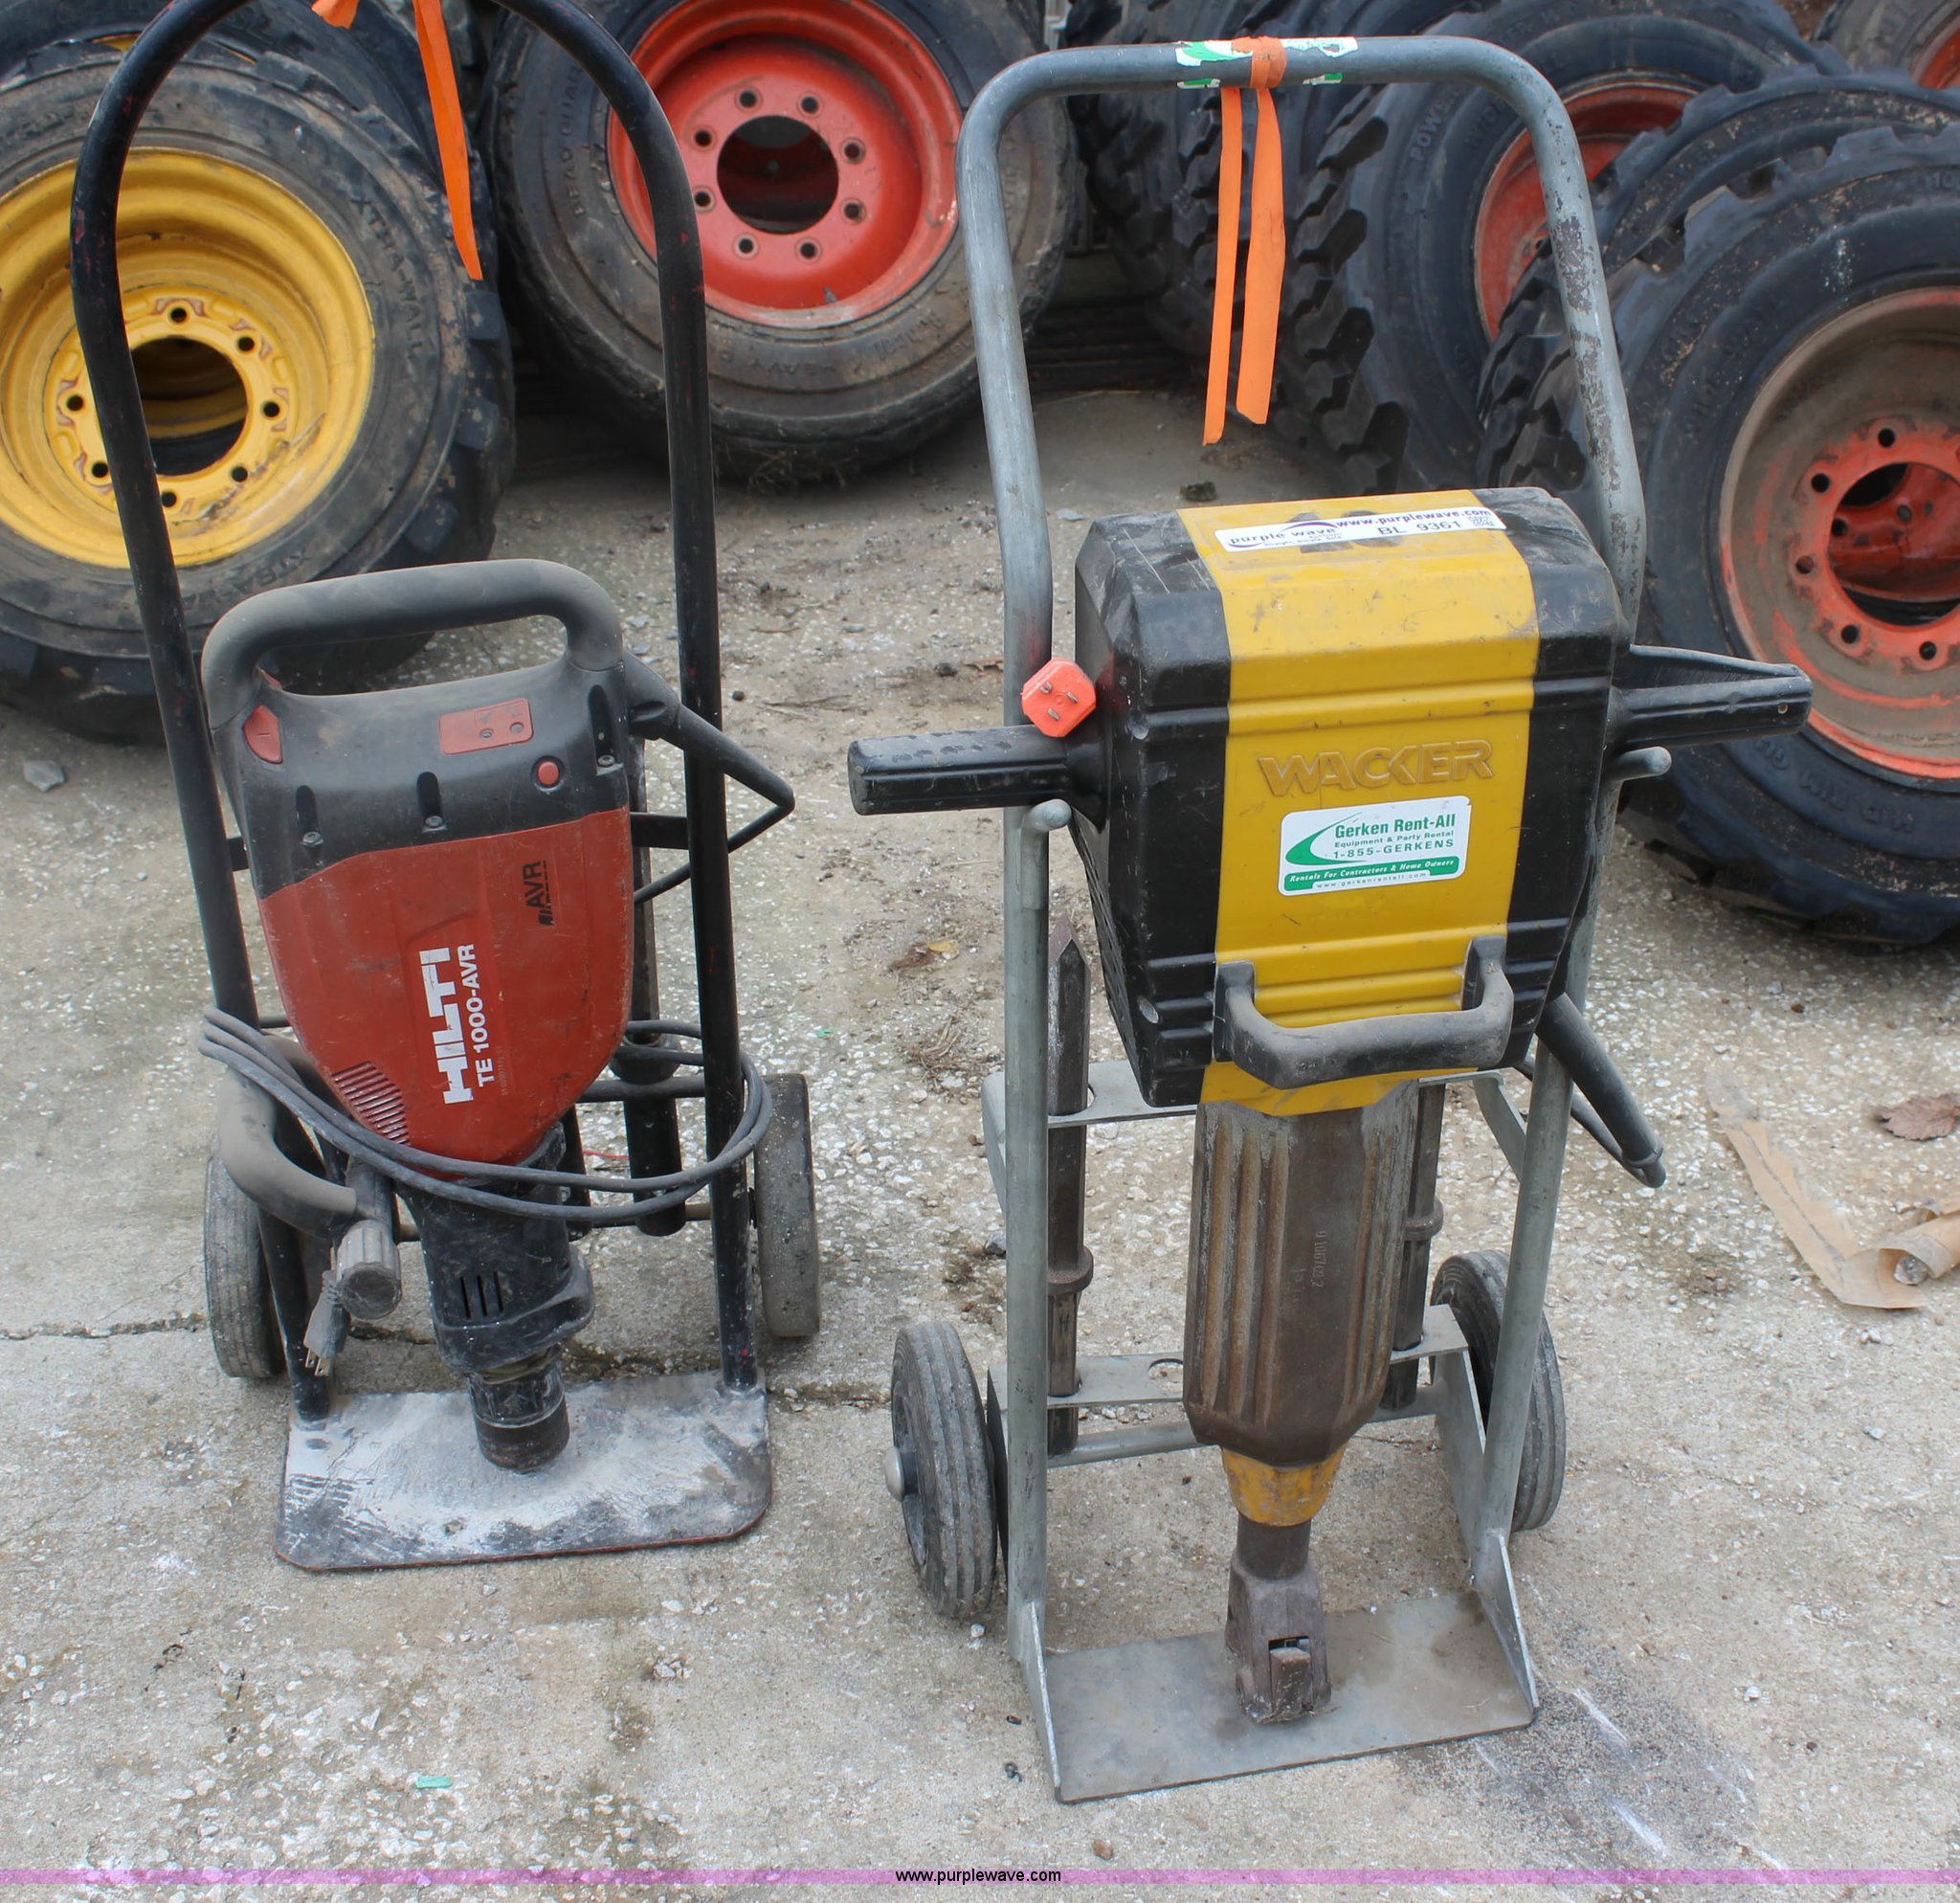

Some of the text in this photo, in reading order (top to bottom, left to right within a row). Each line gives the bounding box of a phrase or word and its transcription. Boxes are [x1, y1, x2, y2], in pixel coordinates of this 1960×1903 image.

[1336, 510, 1492, 527] www.purplewave.com
[1377, 521, 1461, 536] BL 9361
[1230, 532, 1285, 545] purple
[1291, 528, 1336, 538] wave
[1258, 739, 1494, 796] WACKER
[1335, 814, 1456, 839] Gerken Rent-All
[1333, 839, 1454, 860] 1-855-GERKENS
[1334, 838, 1383, 849] Equipment
[1396, 834, 1421, 842] Party
[1424, 830, 1454, 840] Rental
[1289, 872, 1321, 883] Rentals
[1324, 870, 1338, 879] For
[1340, 866, 1388, 878] Contractors
[1399, 862, 1421, 870] Home
[1424, 859, 1455, 868] Owners
[522, 861, 546, 908] AVR
[419, 947, 474, 1104] HILTI
[457, 944, 495, 1087] TE 1000-AVR
